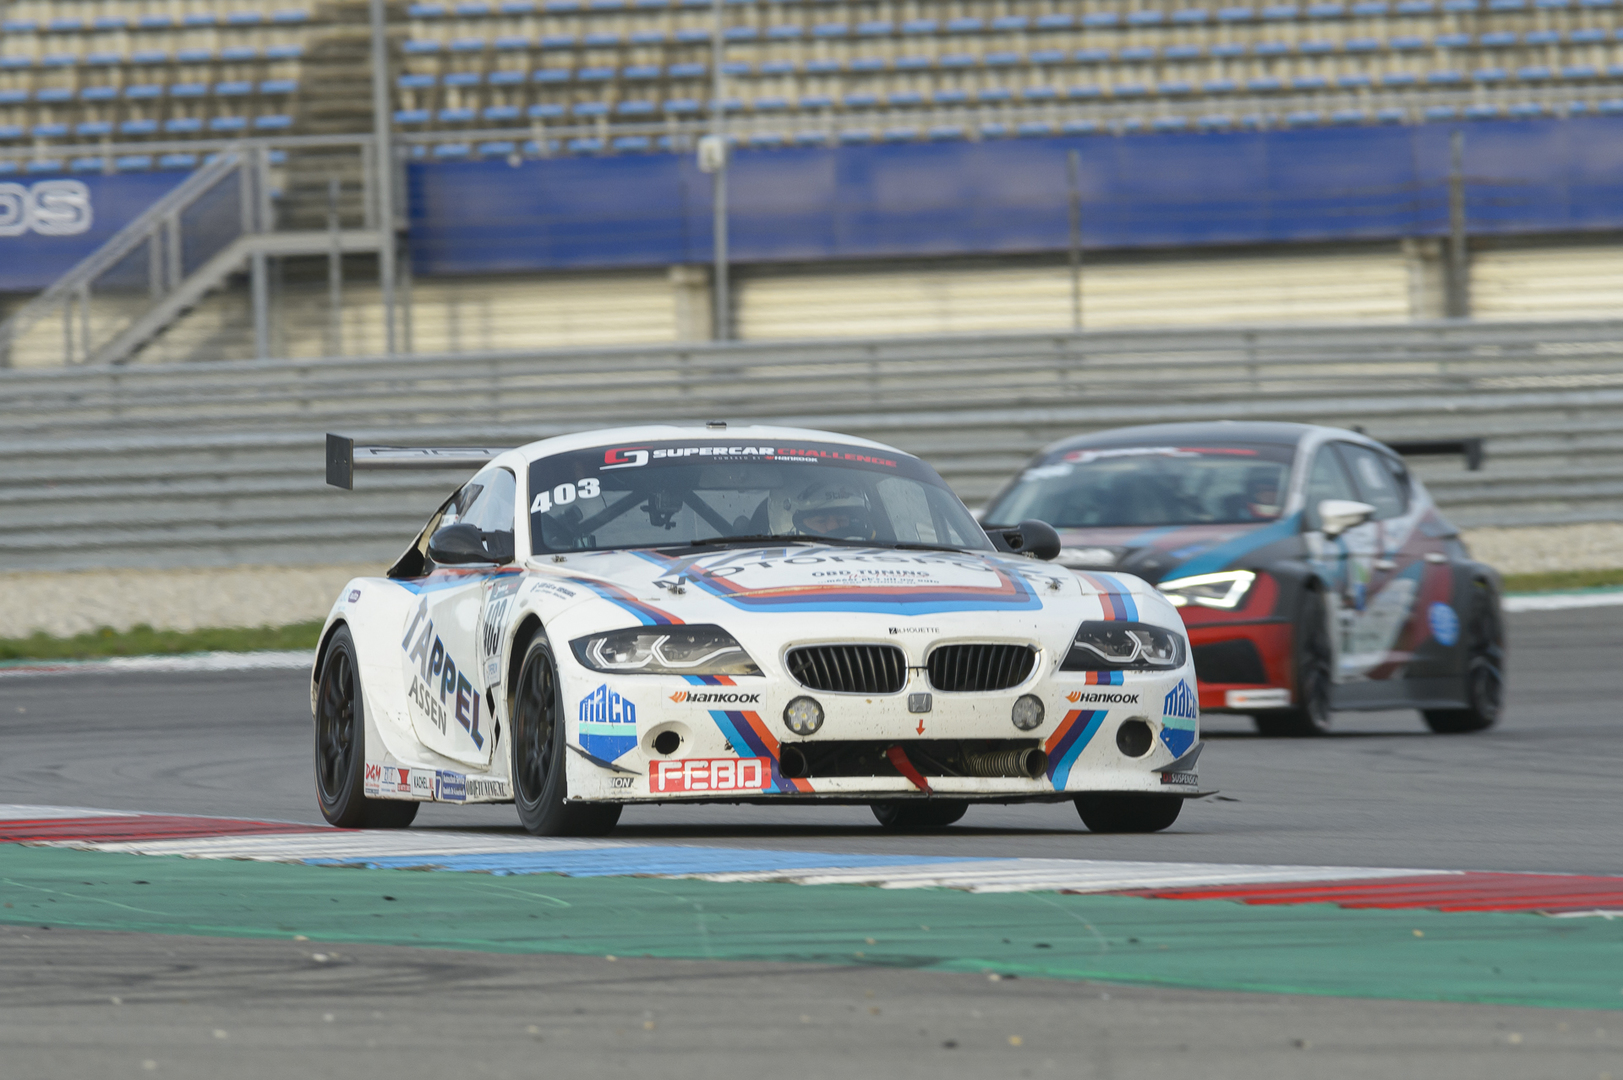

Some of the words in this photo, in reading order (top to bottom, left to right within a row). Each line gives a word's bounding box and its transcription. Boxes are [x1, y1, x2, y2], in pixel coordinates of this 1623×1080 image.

[653, 446, 775, 459] SUPERCAR
[777, 448, 897, 468] CHALLENGE
[530, 477, 601, 514] 403
[812, 569, 851, 578] OBD
[857, 568, 930, 577] TUNING
[402, 594, 485, 751] TAPPEL
[408, 675, 447, 736] ASSEN
[658, 759, 762, 791] FEBO
